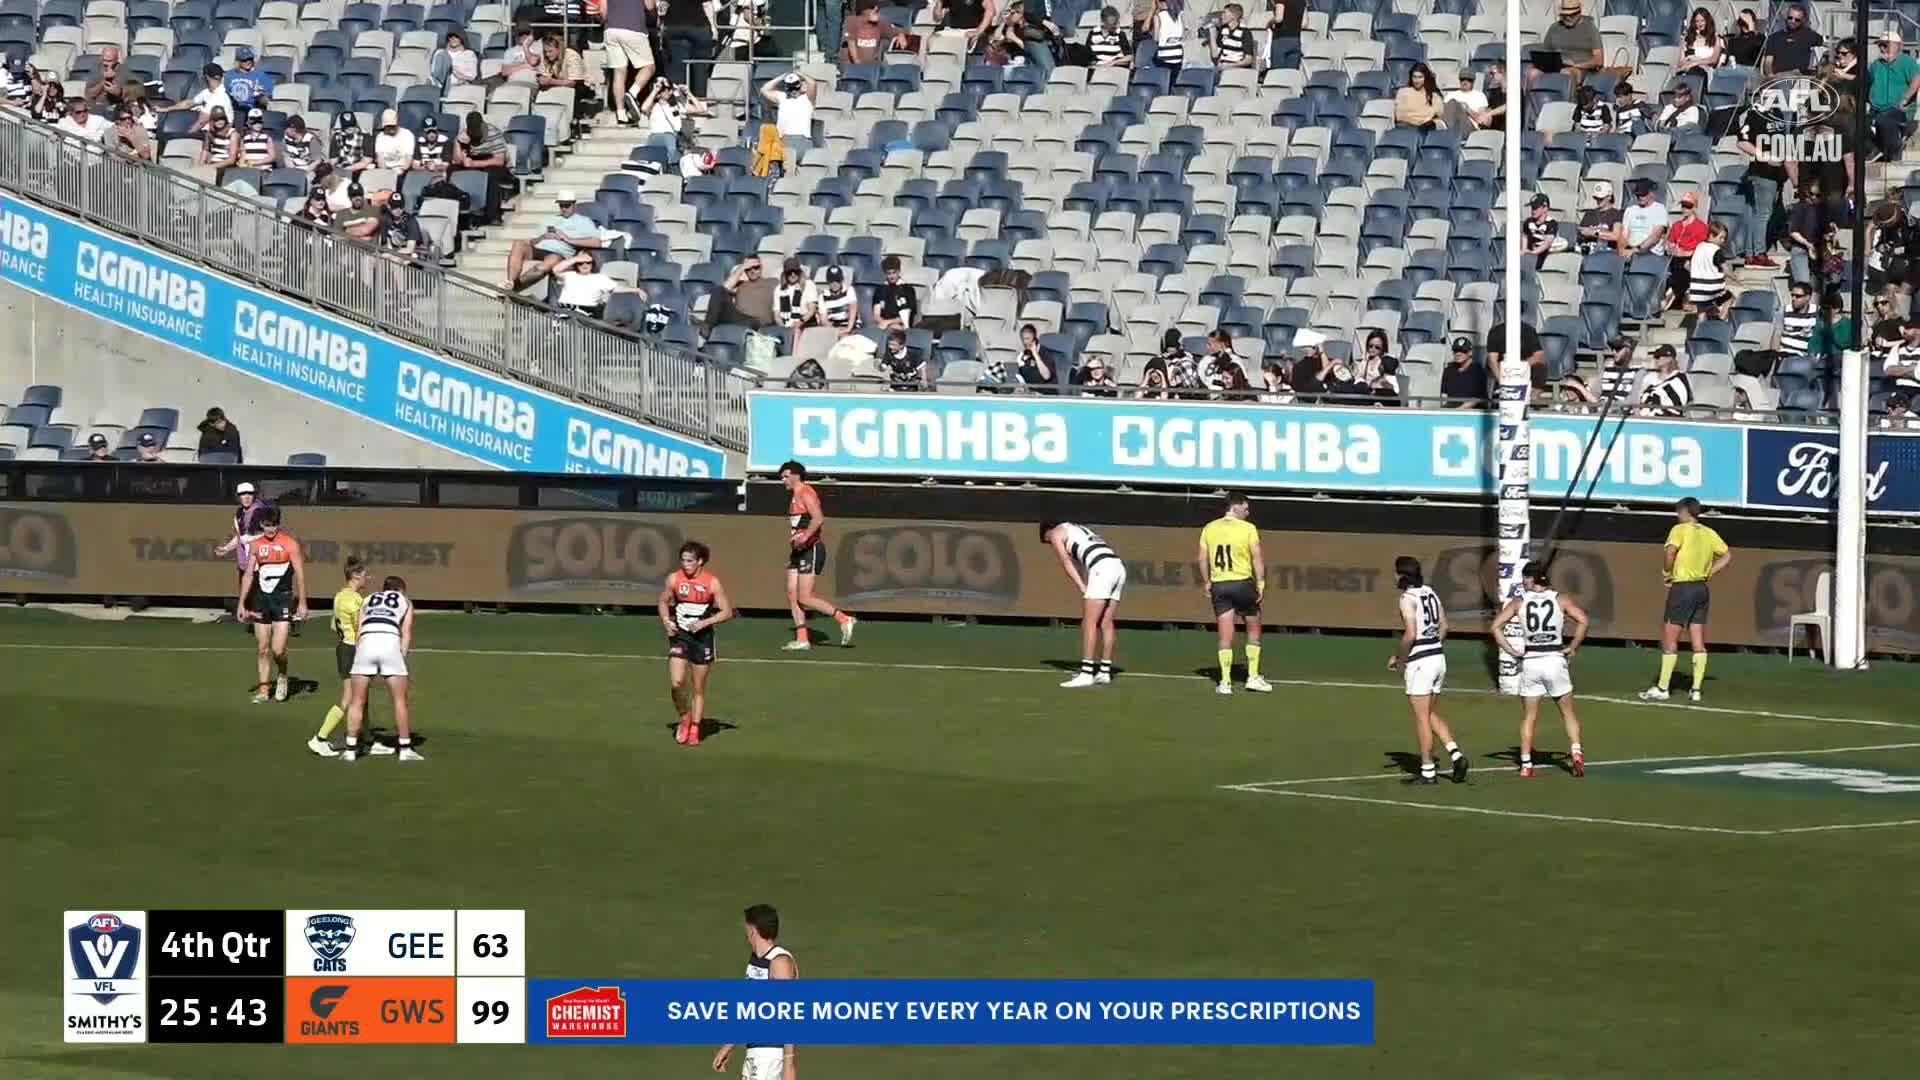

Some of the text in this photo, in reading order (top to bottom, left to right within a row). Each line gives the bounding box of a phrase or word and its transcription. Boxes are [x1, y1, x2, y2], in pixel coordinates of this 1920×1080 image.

[74, 280, 204, 341] HEALTH INSURANCE
[232, 342, 366, 402] HEALTH INSURANCE
[396, 402, 533, 465] HEALTH INSURANCE
[1777, 442, 1889, 502] Fod
[524, 522, 671, 578] SOLO
[853, 530, 1001, 588] SOLO
[1215, 544, 1233, 572] 41
[367, 592, 400, 609] 68
[1419, 593, 1440, 626] 50
[1526, 599, 1556, 632] 62
